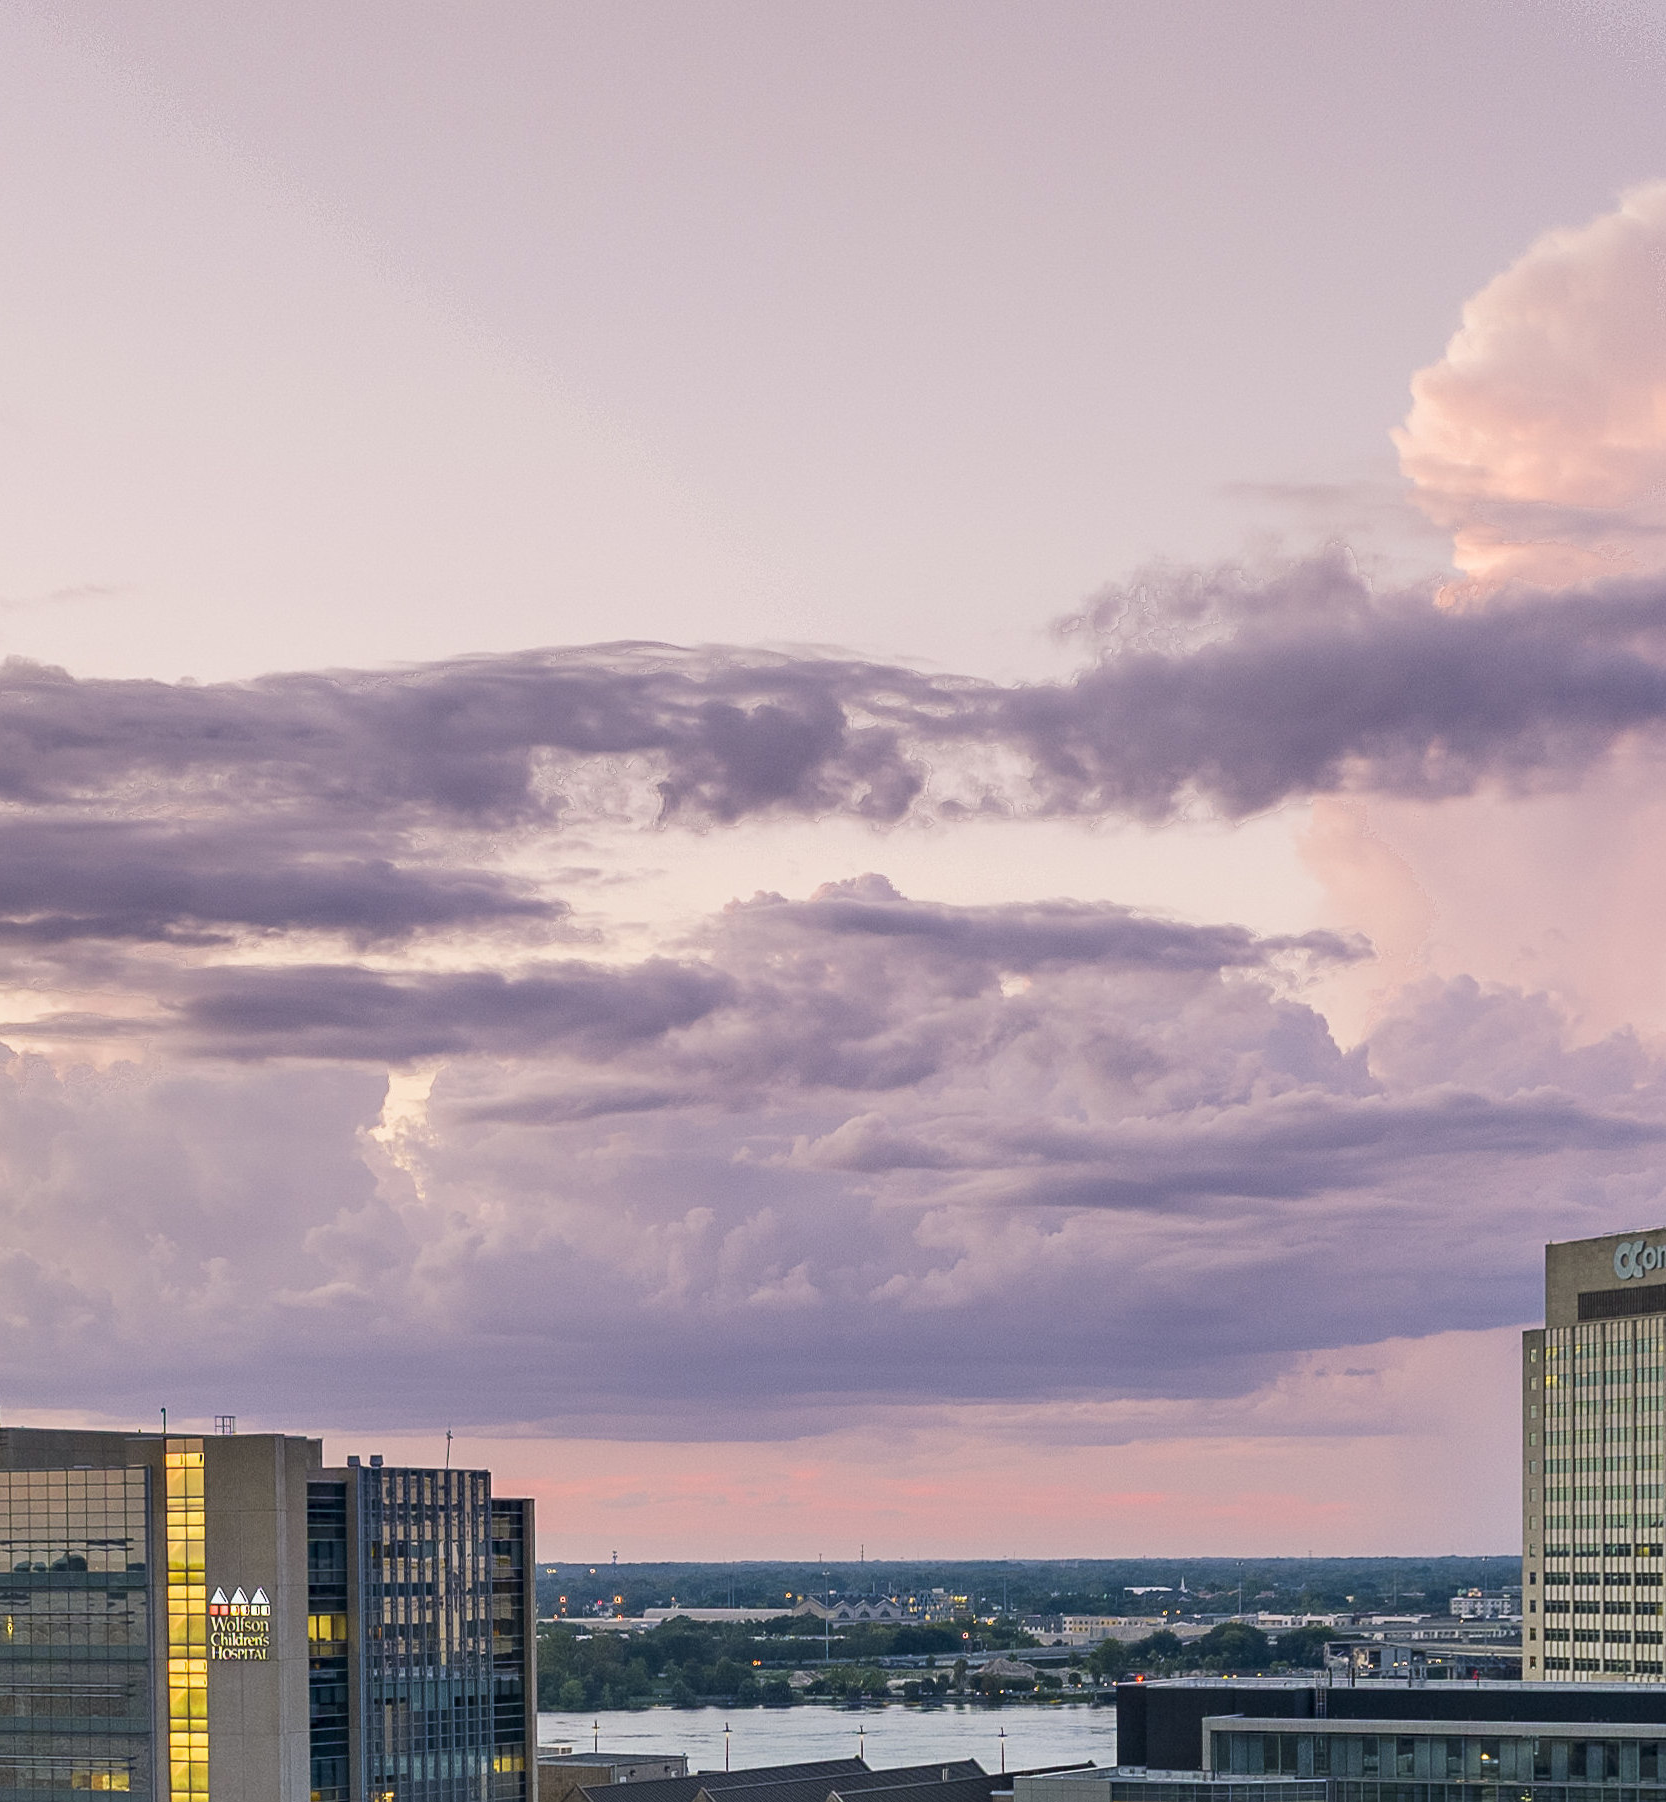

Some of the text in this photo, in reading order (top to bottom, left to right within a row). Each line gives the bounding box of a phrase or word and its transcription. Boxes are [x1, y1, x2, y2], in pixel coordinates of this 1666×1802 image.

[210, 1616, 270, 1632] Wolfson
[210, 1632, 270, 1647] Children's
[211, 1646, 270, 1660] HOSPITAL
